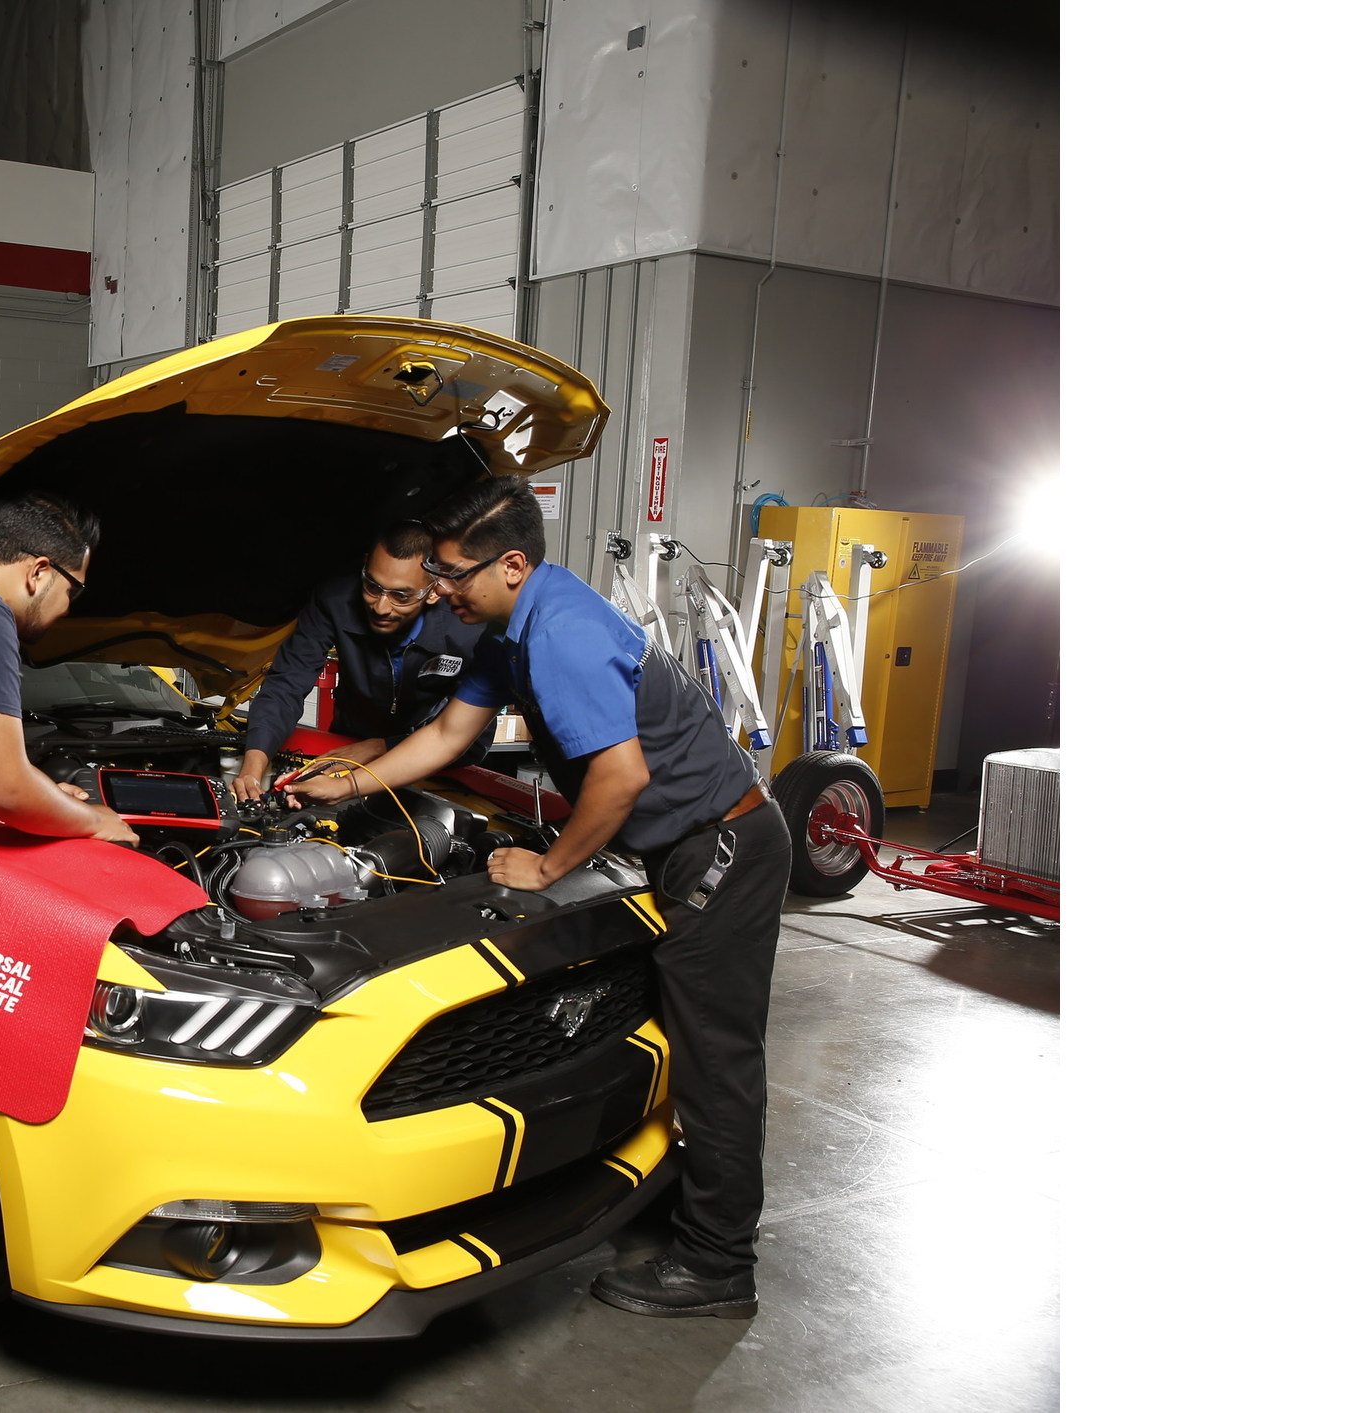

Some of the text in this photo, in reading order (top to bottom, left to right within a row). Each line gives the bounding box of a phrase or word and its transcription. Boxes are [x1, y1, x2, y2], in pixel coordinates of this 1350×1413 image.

[654, 445, 666, 453] FIRE
[653, 457, 662, 515] EXTINGUISHER
[912, 542, 949, 554] FLAMMABLE
[911, 553, 924, 561] KEEP
[923, 553, 934, 562] FIRE
